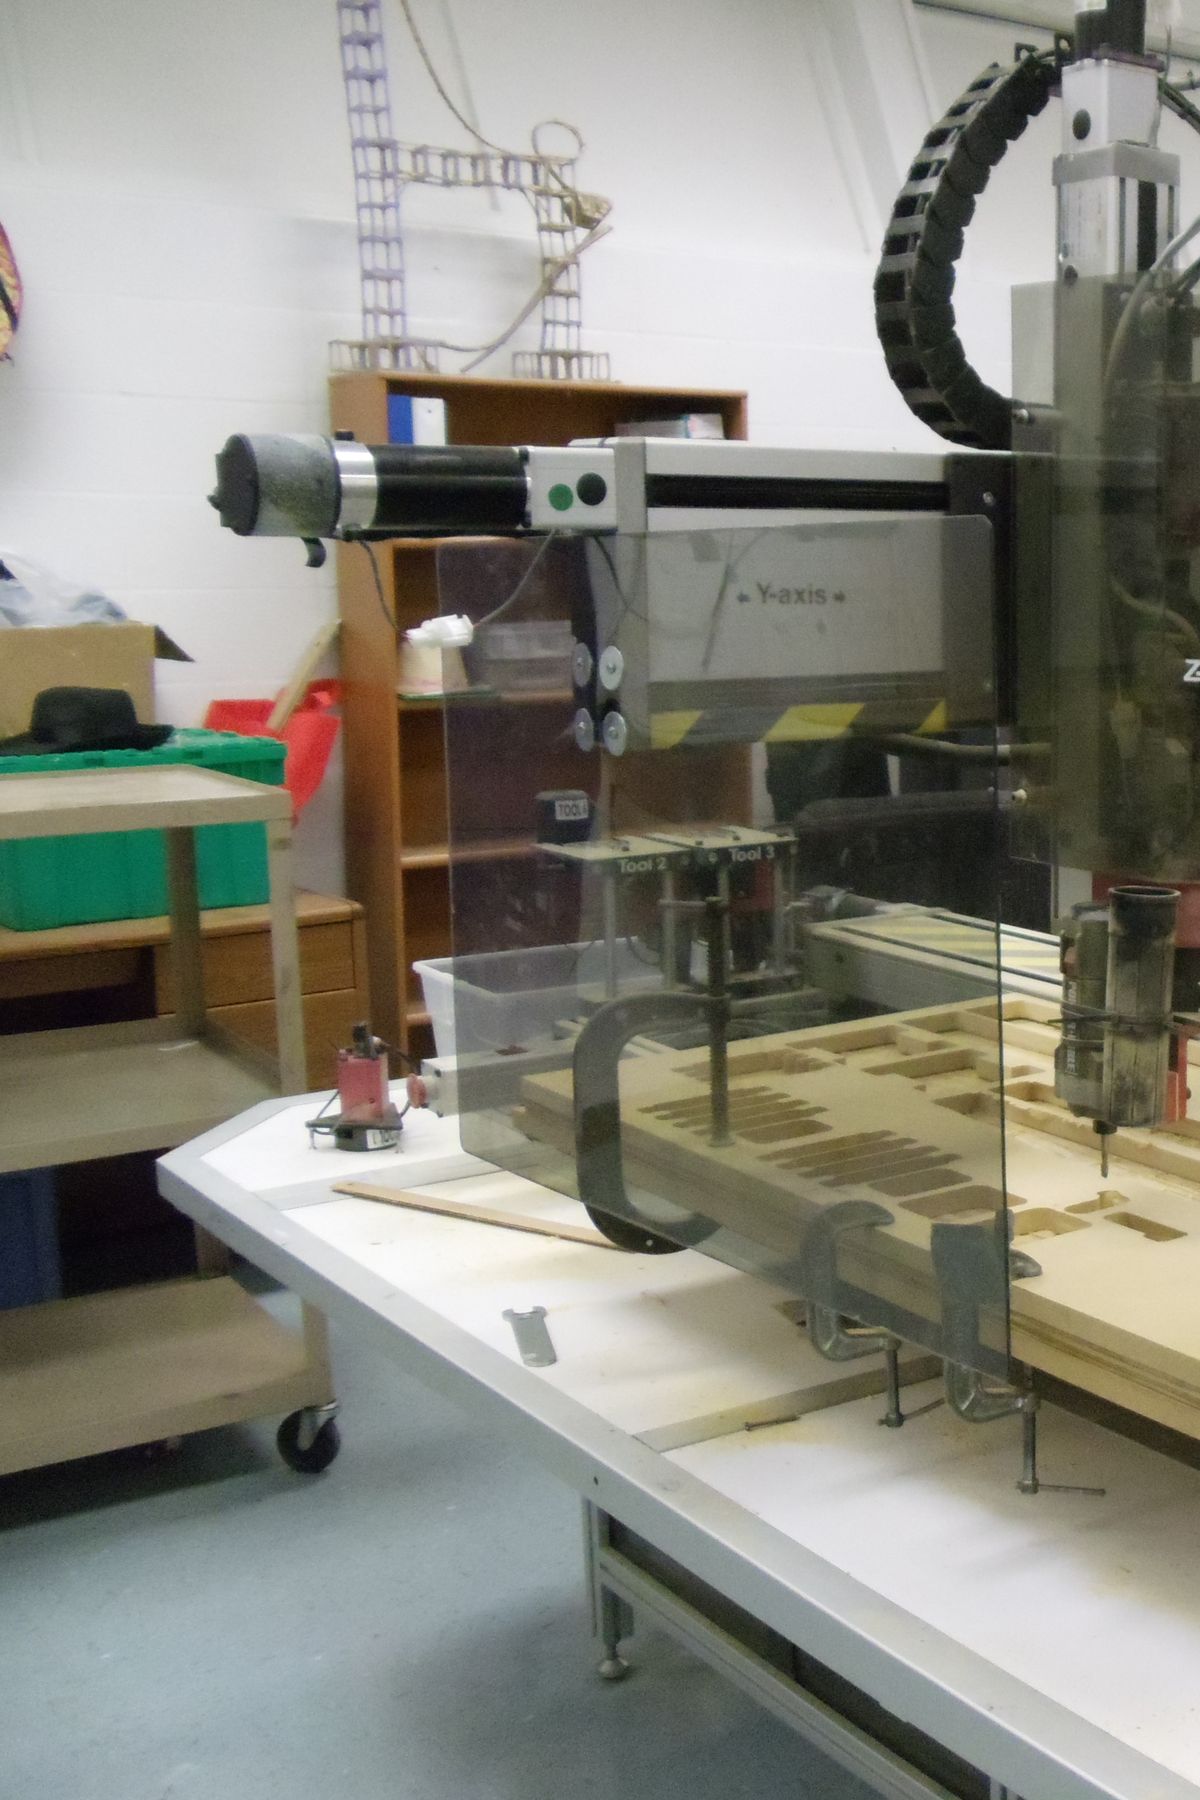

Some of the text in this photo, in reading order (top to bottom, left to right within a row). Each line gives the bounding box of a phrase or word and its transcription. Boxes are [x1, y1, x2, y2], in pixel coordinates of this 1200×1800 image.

[756, 582, 827, 605] Y-axis
[728, 845, 775, 862] Tool 3
[617, 856, 667, 873] Tool 2
